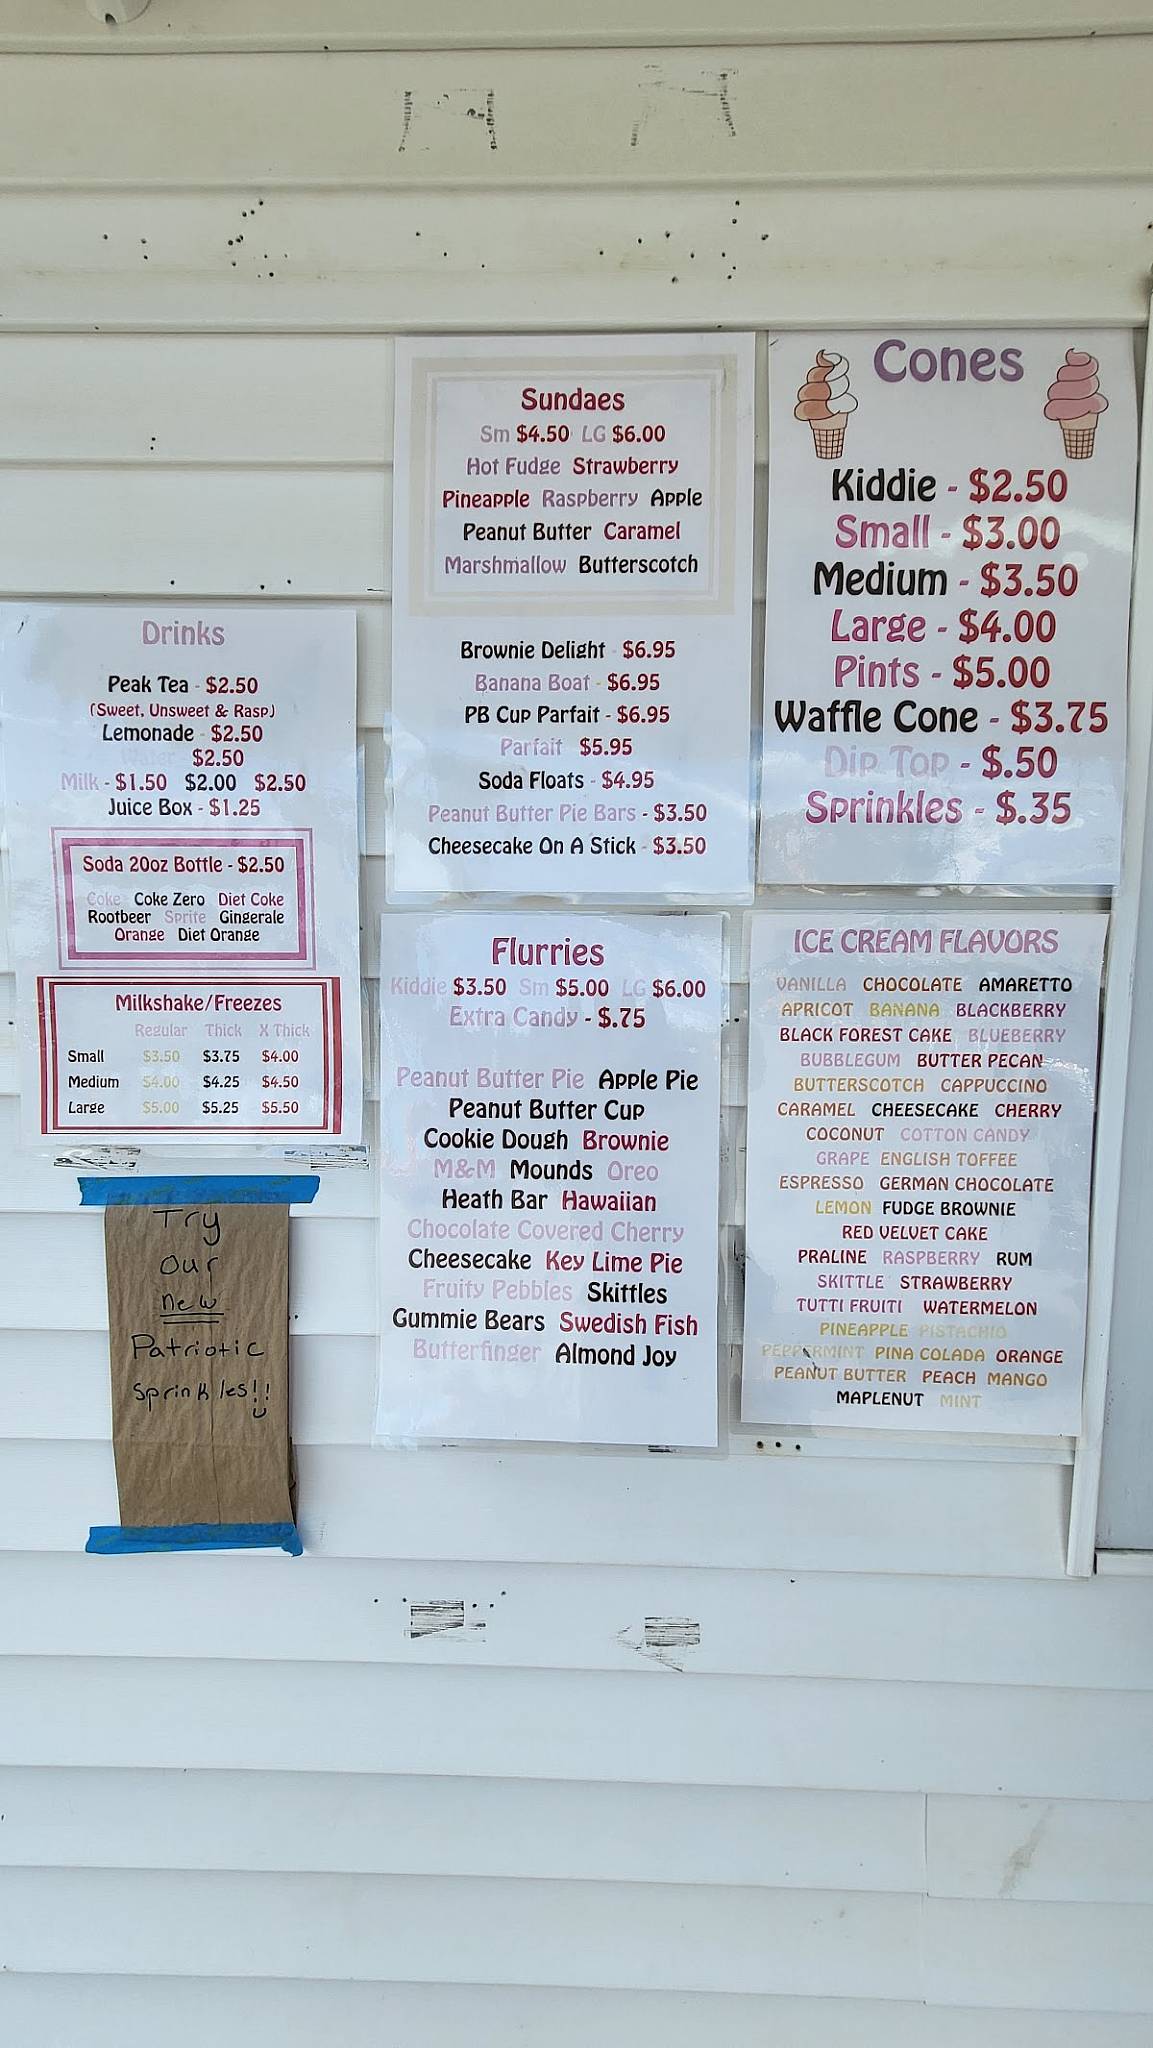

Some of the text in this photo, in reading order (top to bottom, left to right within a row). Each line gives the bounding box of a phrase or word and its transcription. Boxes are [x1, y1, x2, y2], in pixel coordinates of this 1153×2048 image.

[873, 339, 1024, 382] Cones
[521, 387, 625, 412] Sundaes
[517, 424, 665, 443] $4.50 $6.00
[573, 457, 679, 475] Strawberry
[832, 468, 1067, 504] Kiddie $2.50
[442, 488, 702, 508] Pineapple Raspberry Apple
[463, 521, 681, 541] Peanut Butter Caramel
[835, 514, 1060, 550] Small $3.00
[445, 555, 698, 575] Marshmallow Butterscotch
[814, 561, 1078, 597] Medium $3.50
[142, 620, 225, 646] Drinks
[831, 608, 1056, 644] Large $4.00
[460, 640, 675, 660] Brownie Delight $6.95
[834, 655, 1050, 689] Pints $5.00
[108, 675, 258, 695] Peak Tea $2.50
[607, 673, 660, 692] $6.95
[90, 703, 276, 719] (Sweet, Unsweet Rasp)
[465, 705, 670, 724] PB Cup Parfait $6.95
[775, 700, 1108, 735] Waffle Cone $3.75
[103, 724, 263, 743] Lemonade $2.50
[580, 737, 633, 757] $5.95
[192, 749, 244, 768] $2.50
[982, 744, 1057, 780] $.50
[115, 773, 306, 792] $1.50 $2.00 $2.50
[479, 770, 655, 790] Soda Floats $4.95
[108, 798, 260, 817] Juice Box $1.25
[653, 804, 707, 823] $3.50
[805, 790, 1071, 826] Sprinkles $.35
[428, 836, 706, 856] Cheesecake On Stick $3.50
[83, 855, 285, 874] Soda 20oz Bottle $2.50
[134, 892, 284, 907] Coke Zero Diet Coke
[88, 910, 284, 925] Rootbeer Gingerale
[114, 928, 260, 942] Orange Diet Orange
[794, 929, 1059, 955] ICE CREAM FLAVORS
[492, 937, 604, 966] Flurries
[453, 977, 705, 998] $3.50 $5.00 $6.00
[863, 977, 1072, 993] CHOCOLATE AMARETTO
[115, 994, 282, 1012] Milkshake/Freezes
[956, 1003, 1066, 1018] BLACKBERRY
[598, 1007, 645, 1028] $.75
[780, 1028, 952, 1043] BLACK FOREST CAKE
[68, 1049, 299, 1064] Small $3.75 $4.00
[917, 1053, 1043, 1068] BUTTER PECAN
[68, 1075, 299, 1089] Medium $4.25 $4.50
[599, 1069, 699, 1090] Apple Pie
[941, 1079, 1047, 1093] CAPPUCCINO
[68, 1100, 299, 1115] Large $5.25 $5.50
[449, 1098, 644, 1120] Peanut Butter Cup
[777, 1102, 1062, 1118] CARAMEL CHEESECAKE CHERRY
[424, 1128, 669, 1151] Cookie Dough Brownie
[806, 1127, 884, 1142] COCONUT
[510, 1160, 593, 1180] Mounds
[779, 1175, 1054, 1193] ESPRESSO GERMAN CHOCOLATE
[442, 1189, 656, 1212] Heath Bar Hawaiian
[883, 1201, 1016, 1217] FUDGE BROWNIE
[153, 1208, 221, 1246] Try
[842, 1225, 988, 1241] RED VELVET CAKE
[408, 1248, 683, 1273] Cheesecake Key Lime Pie
[798, 1249, 1032, 1267] PRALINE RUM
[817, 1274, 1013, 1291] SKITTLE STRAWBERRY
[162, 1293, 216, 1312] new
[587, 1282, 667, 1304] Skittles
[923, 1300, 1038, 1316] WATERMELON
[393, 1308, 698, 1336] Gummie Bears Swedish Fish
[131, 1333, 265, 1359] Patriotic
[555, 1343, 677, 1367] Almond Joy
[996, 1349, 1063, 1364] ORANGE
[922, 1370, 976, 1385] PEACH
[837, 1391, 924, 1407] MAPLENUT
